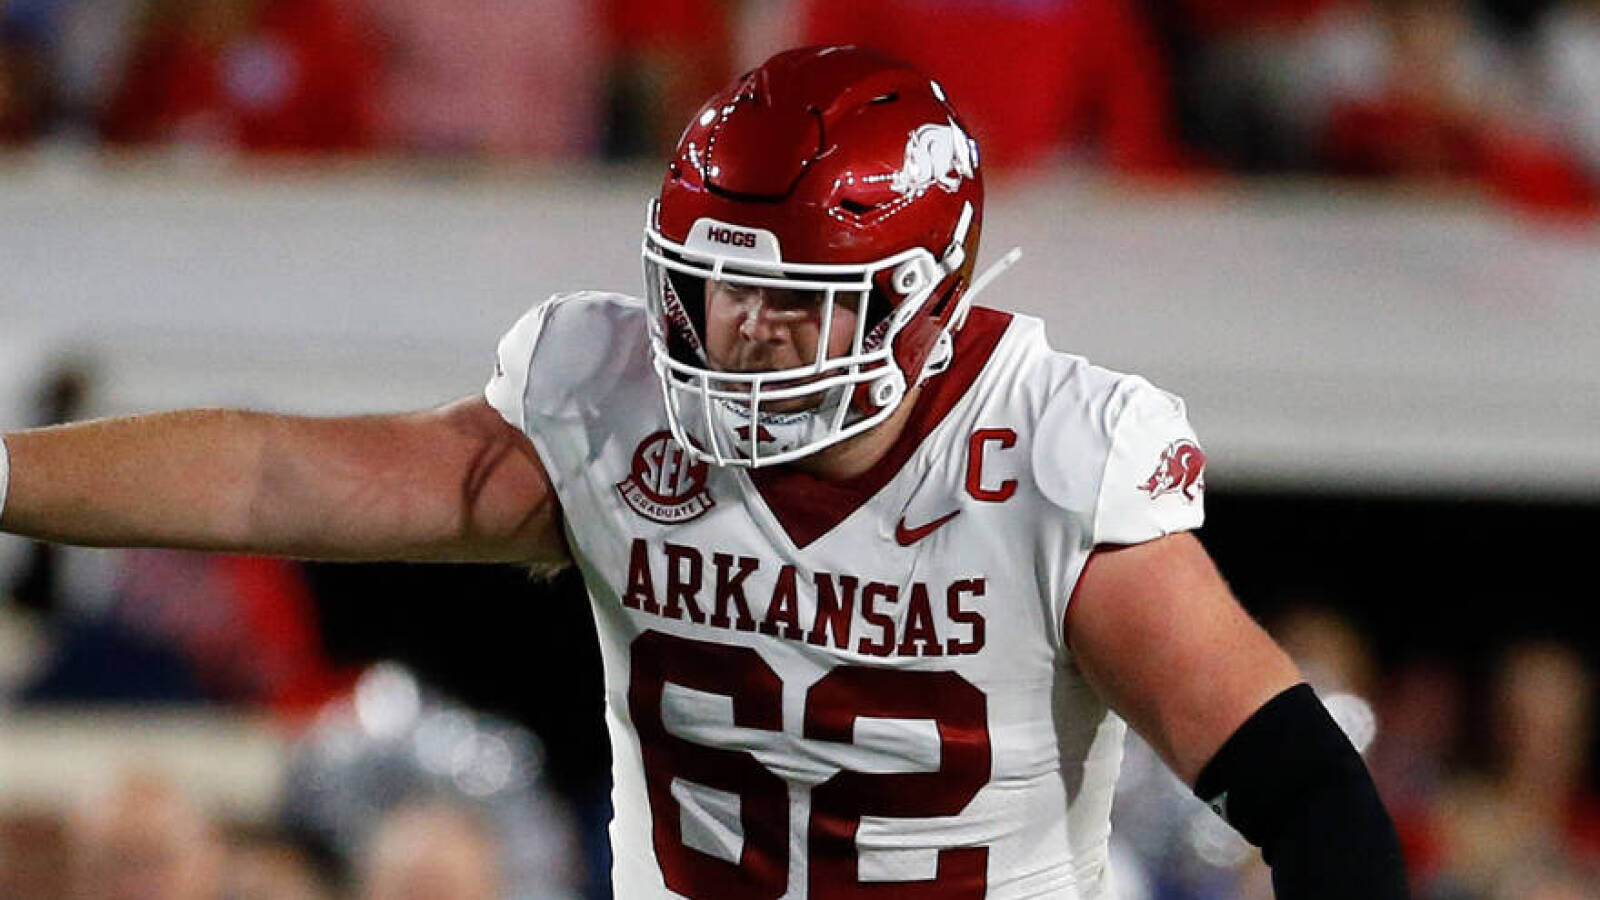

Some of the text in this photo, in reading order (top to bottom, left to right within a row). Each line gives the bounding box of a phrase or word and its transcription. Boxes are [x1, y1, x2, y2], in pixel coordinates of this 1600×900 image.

[707, 225, 757, 248] HOGS
[641, 438, 696, 496] SEC
[965, 427, 1018, 503] C
[631, 493, 696, 518] GRADUATE
[622, 538, 987, 657] ARKANSAS
[627, 628, 992, 900] 62
